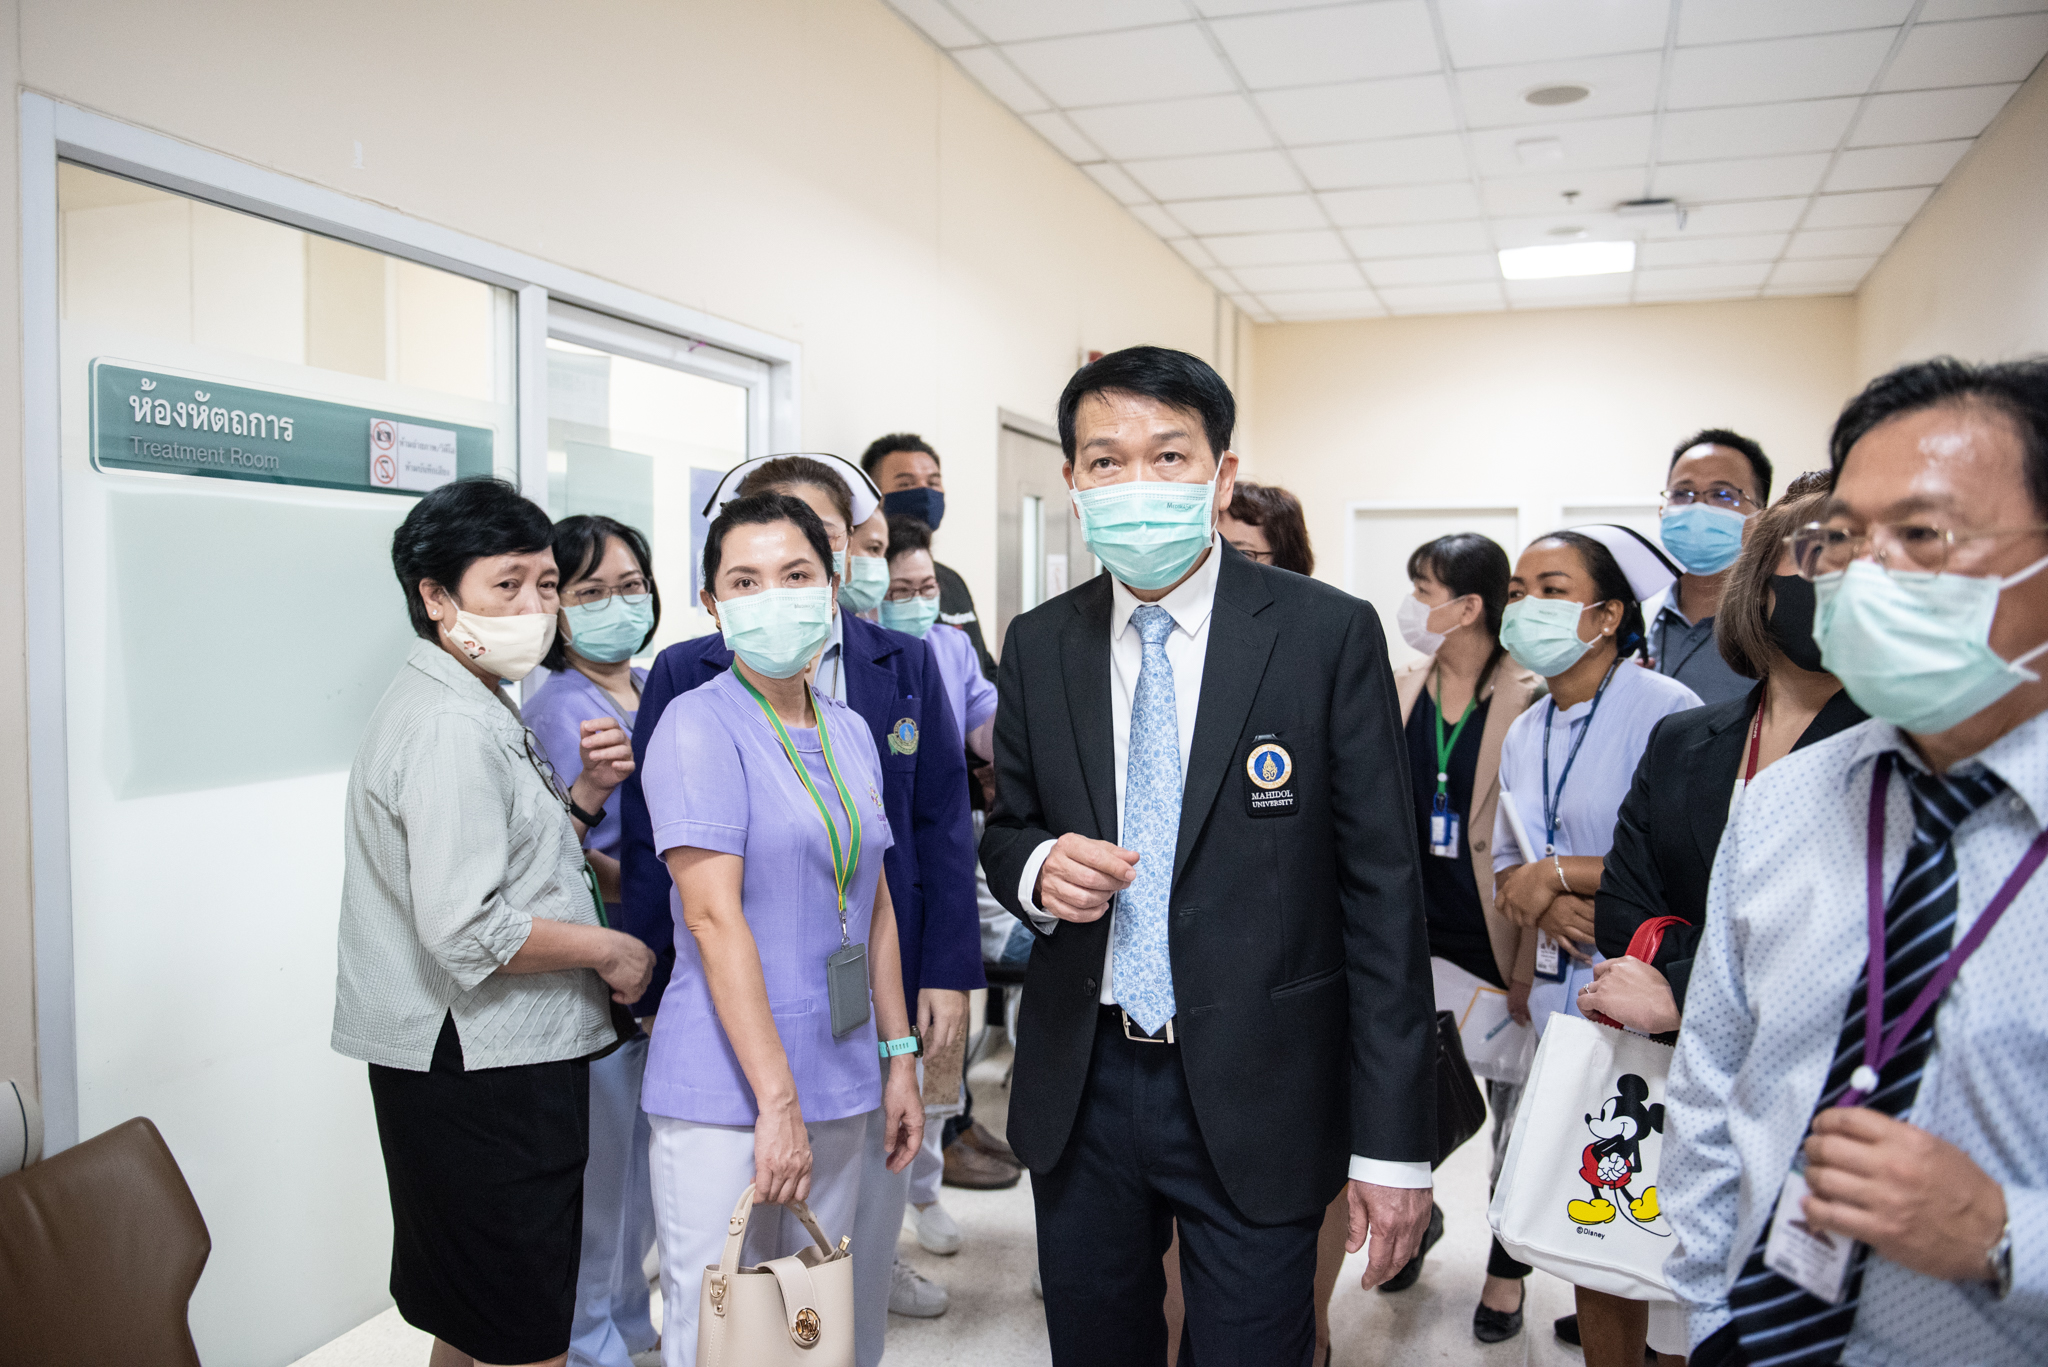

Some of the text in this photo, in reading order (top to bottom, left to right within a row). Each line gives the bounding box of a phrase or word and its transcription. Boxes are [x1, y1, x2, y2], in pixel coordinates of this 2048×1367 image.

[129, 377, 294, 442] ห้องหัตถการ
[130, 436, 279, 469] Treatment Room
[1251, 790, 1293, 800] MAHIDOL
[1252, 799, 1293, 808] UNIVERSITY
